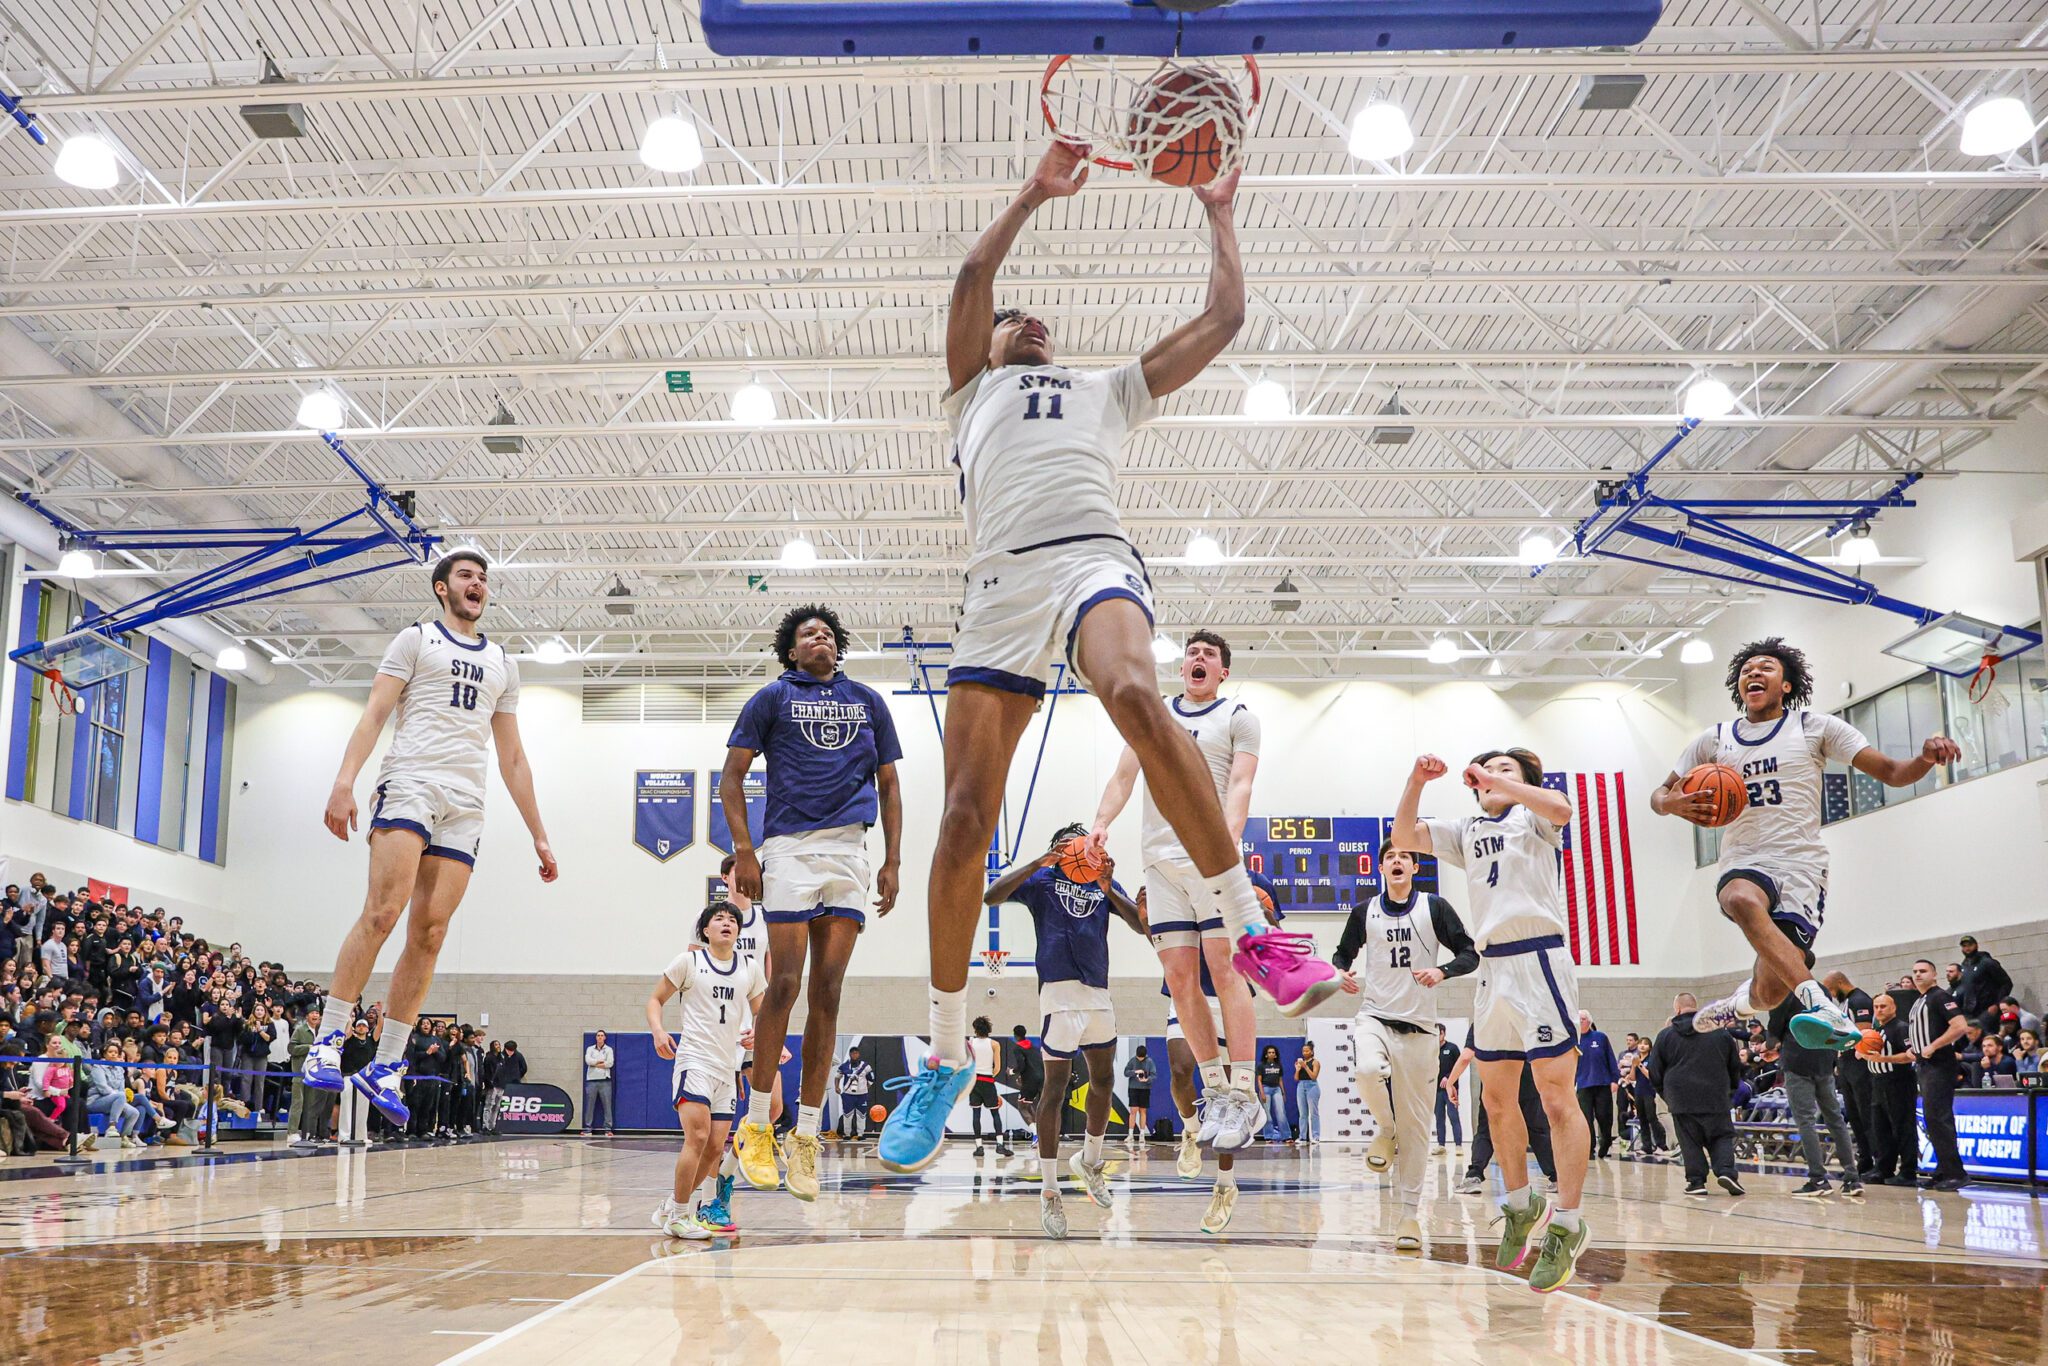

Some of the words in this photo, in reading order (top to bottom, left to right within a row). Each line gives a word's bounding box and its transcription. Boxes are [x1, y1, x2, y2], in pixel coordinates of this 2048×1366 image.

[1019, 374, 1071, 390] STM
[1023, 392, 1063, 420] 11
[451, 659, 484, 683] STM
[450, 682, 477, 711] 10
[791, 703, 866, 720] CHANCELLORS
[1743, 756, 1778, 779] STM
[1746, 779, 1783, 807] 23
[1338, 842, 1369, 852] GUEST
[1474, 835, 1504, 858] STM
[1359, 854, 1371, 874] 0
[1486, 860, 1499, 888] 4
[1055, 882, 1105, 899] CHANCEORS
[1272, 878, 1288, 886] PLYR
[1294, 878, 1310, 886] FOUL
[1318, 878, 1331, 886] PTS
[1355, 878, 1377, 886] FOULS
[736, 938, 756, 950] STM
[1386, 928, 1412, 942] STM
[1390, 946, 1411, 968] 12
[713, 985, 734, 1000] STM
[719, 1004, 726, 1024] 1
[503, 1112, 565, 1122] NETWORK
[2009, 1116, 2027, 1136] OF
[1976, 1139, 2022, 1160] JOSEPH
